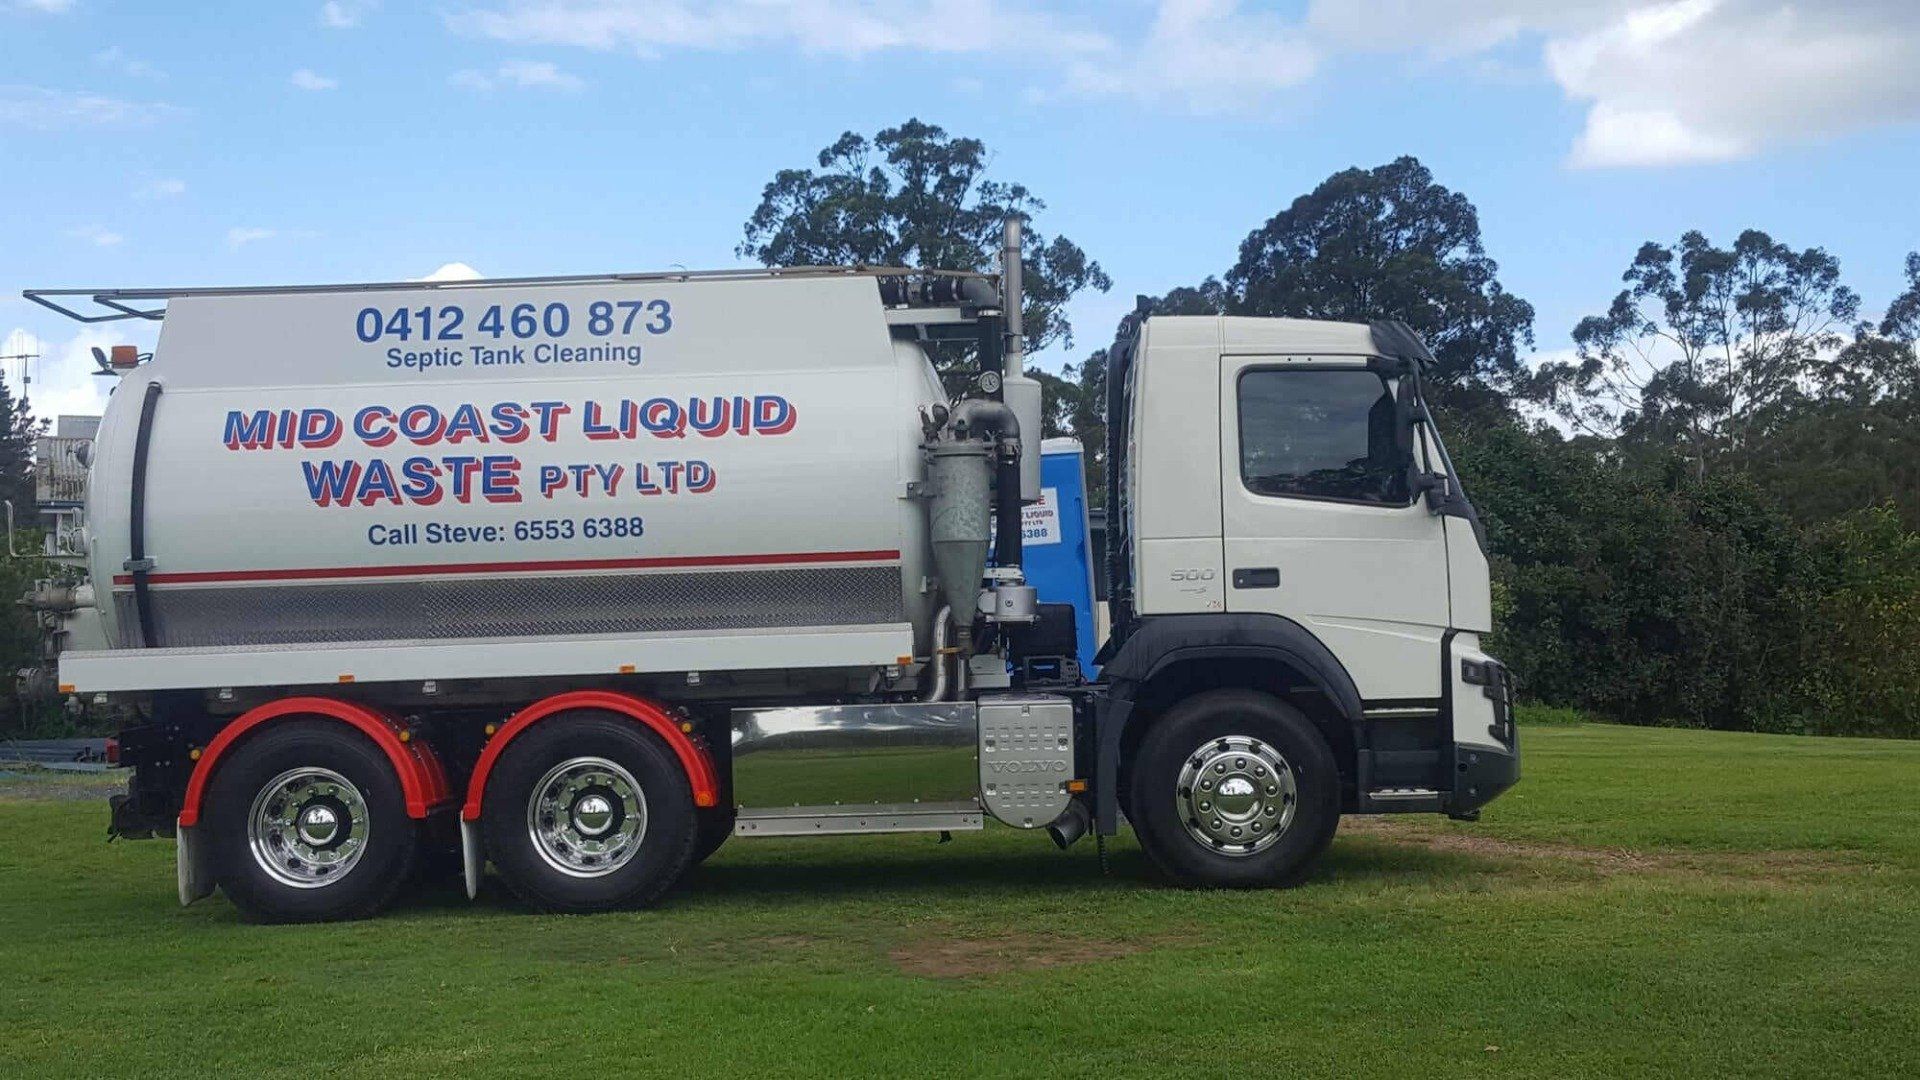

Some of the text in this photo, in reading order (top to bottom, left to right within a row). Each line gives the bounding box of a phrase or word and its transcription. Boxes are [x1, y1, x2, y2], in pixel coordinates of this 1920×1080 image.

[356, 299, 673, 343] 0412 460 873
[386, 342, 642, 372] Septic Tank Cleaning
[223, 394, 797, 450] MID COAST LIQUID
[302, 454, 717, 507] WASTE PTY LTD
[367, 516, 644, 546] Call Steve: 6553 6388
[1170, 568, 1215, 582] 500
[988, 759, 1068, 773] VOLVO
